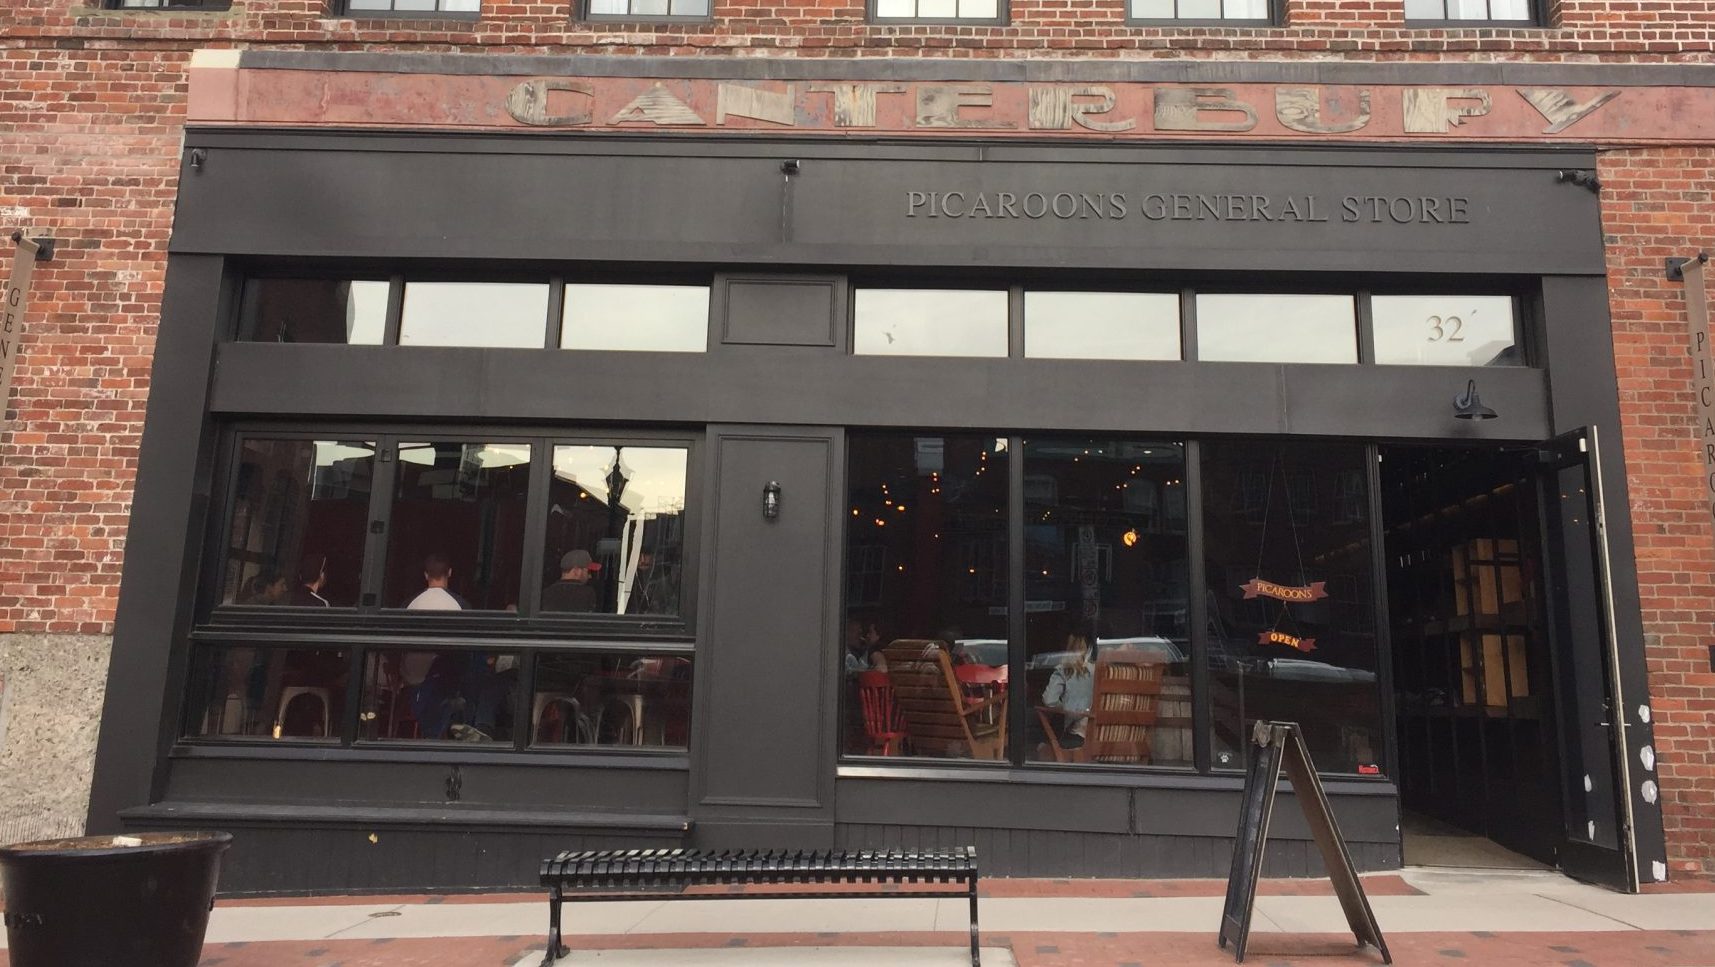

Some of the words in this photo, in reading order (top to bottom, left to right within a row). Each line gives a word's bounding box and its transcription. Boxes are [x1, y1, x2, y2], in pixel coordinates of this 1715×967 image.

[906, 191, 1127, 219] PICAROONS
[1141, 194, 1327, 222] GENERAL
[1342, 196, 1470, 225] STORE
[1426, 315, 1465, 341] 32
[1697, 331, 1715, 521] PICARO
[1257, 582, 1312, 598] PICAROONS
[1270, 632, 1299, 647] OPEN
